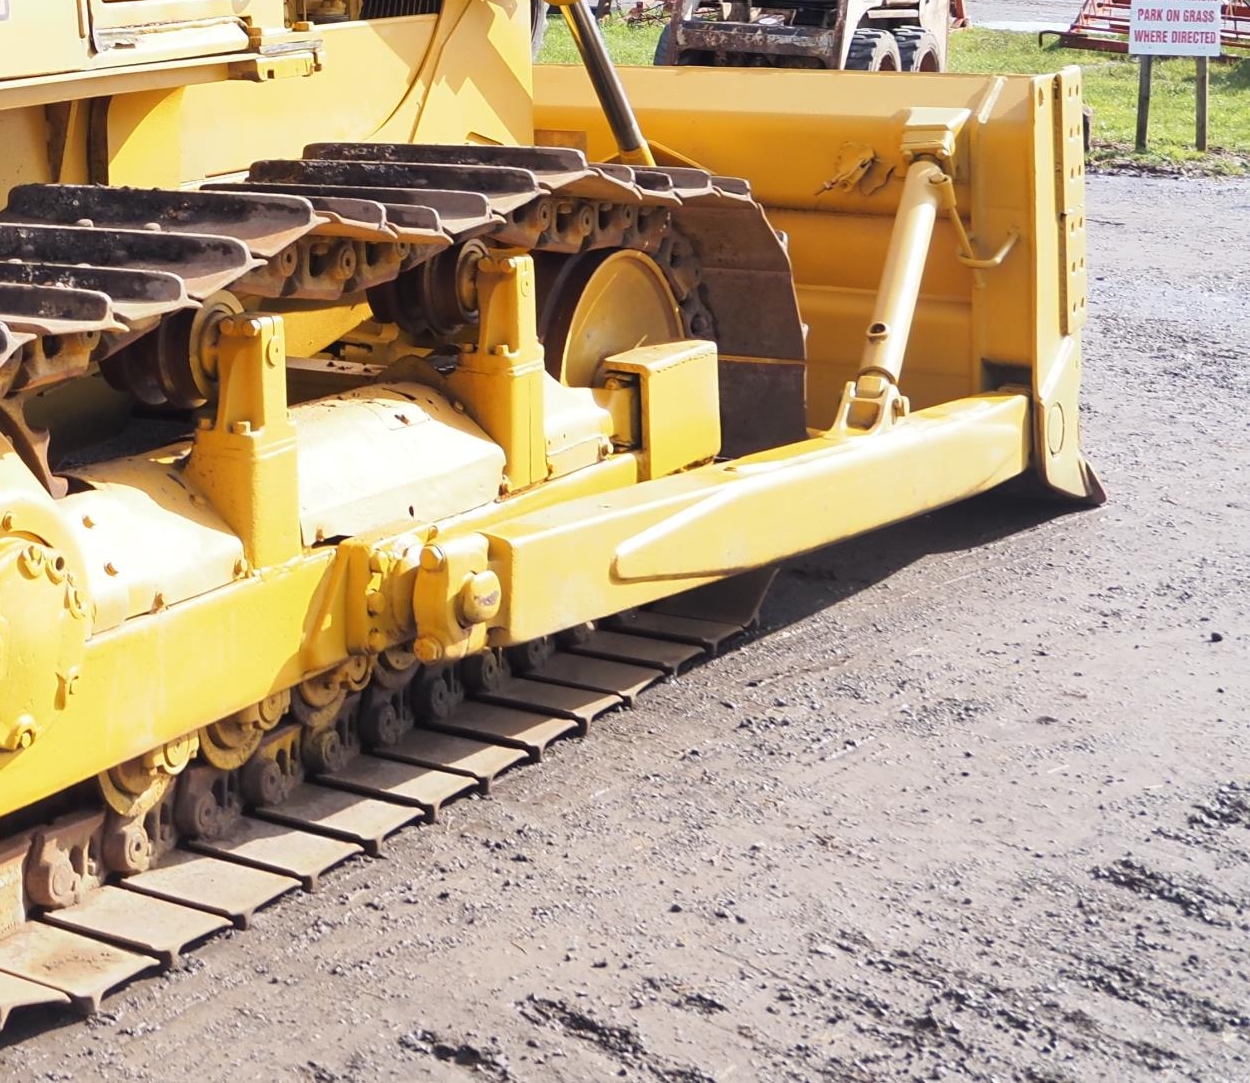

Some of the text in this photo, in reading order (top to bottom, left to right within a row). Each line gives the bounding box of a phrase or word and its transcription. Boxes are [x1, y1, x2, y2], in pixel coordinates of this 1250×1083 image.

[1137, 8, 1215, 23] PARK ON GRASS
[1134, 30, 1216, 44] WHERE DIRECTED
